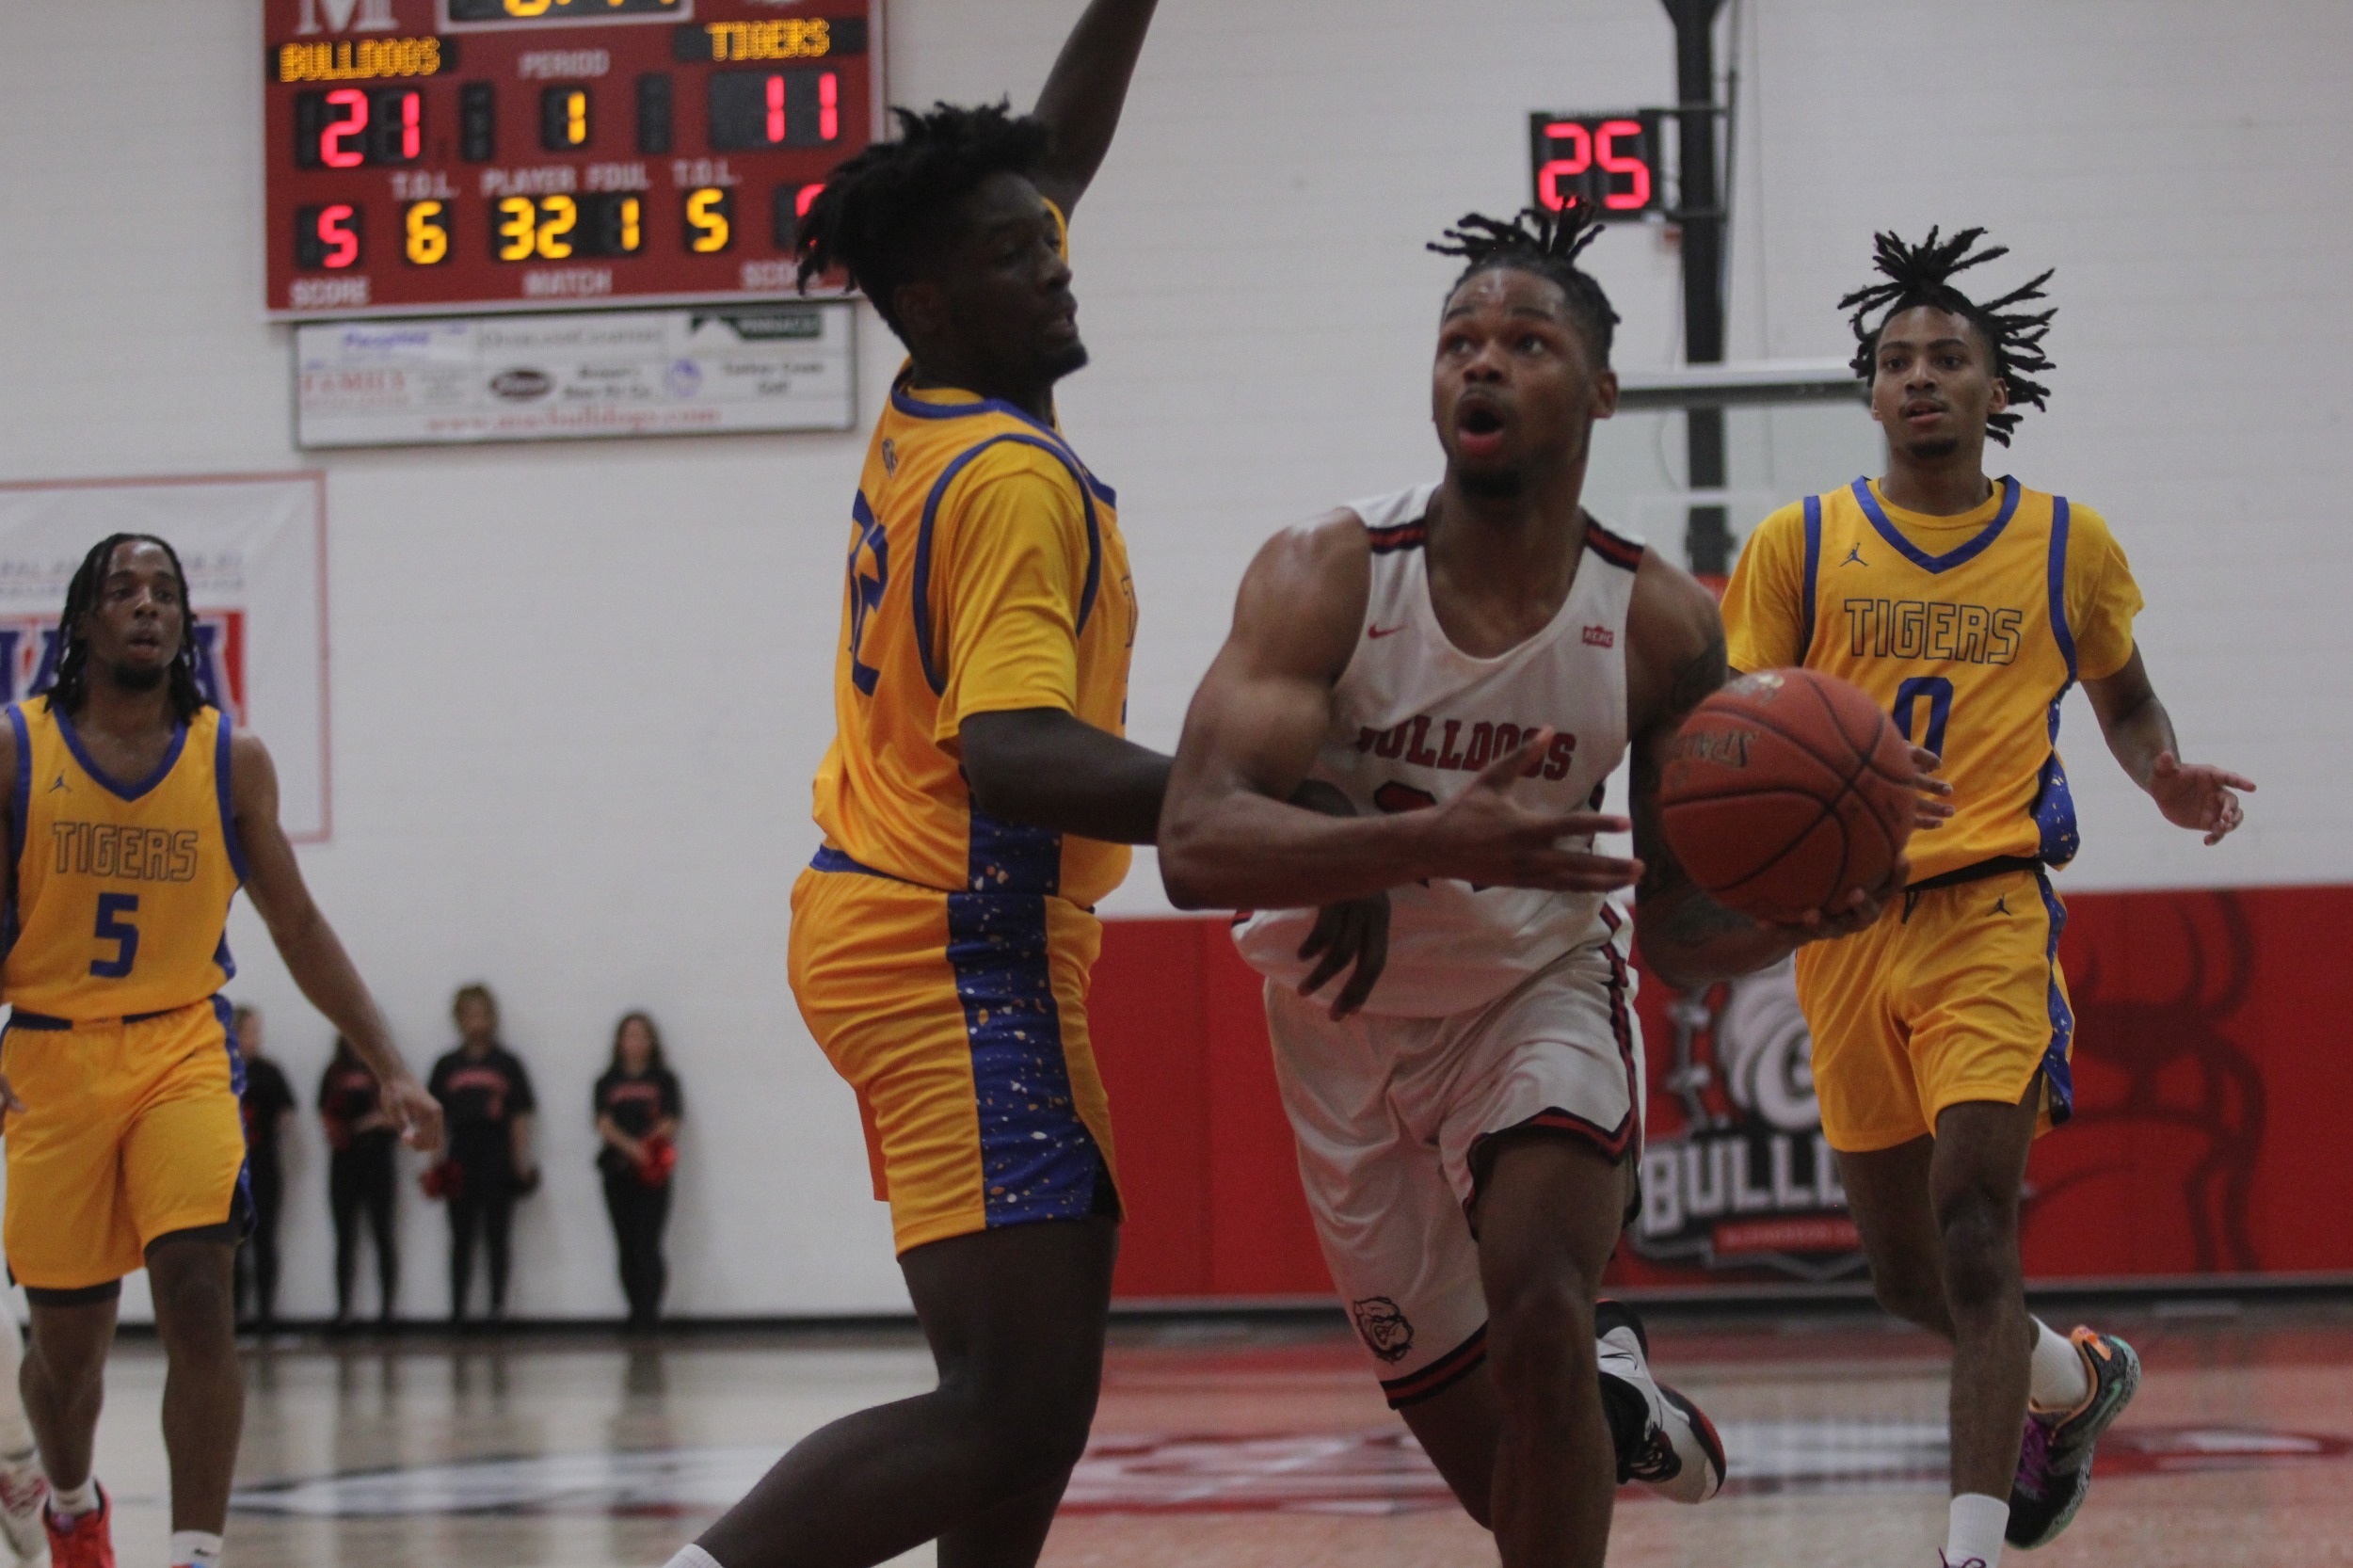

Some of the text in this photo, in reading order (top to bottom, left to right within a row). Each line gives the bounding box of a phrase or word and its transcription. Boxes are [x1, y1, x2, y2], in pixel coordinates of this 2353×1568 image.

[280, 37, 440, 82] BULLDOGS
[519, 49, 610, 79] PERIOD
[320, 88, 421, 168] 21
[567, 91, 586, 145] 1
[766, 72, 839, 142] 11
[481, 162, 651, 197] PLAYER FOUL
[1538, 120, 1651, 211] 25
[317, 204, 359, 268] 5
[407, 200, 448, 265] 6
[499, 195, 577, 262] 32
[621, 198, 640, 251] 1
[686, 187, 729, 253] 5
[289, 277, 370, 309] SCORE
[523, 267, 612, 297] MATCH
[1845, 599, 2023, 665] TIGERS
[53, 822, 198, 883] TIGERS
[89, 892, 139, 979] 5
